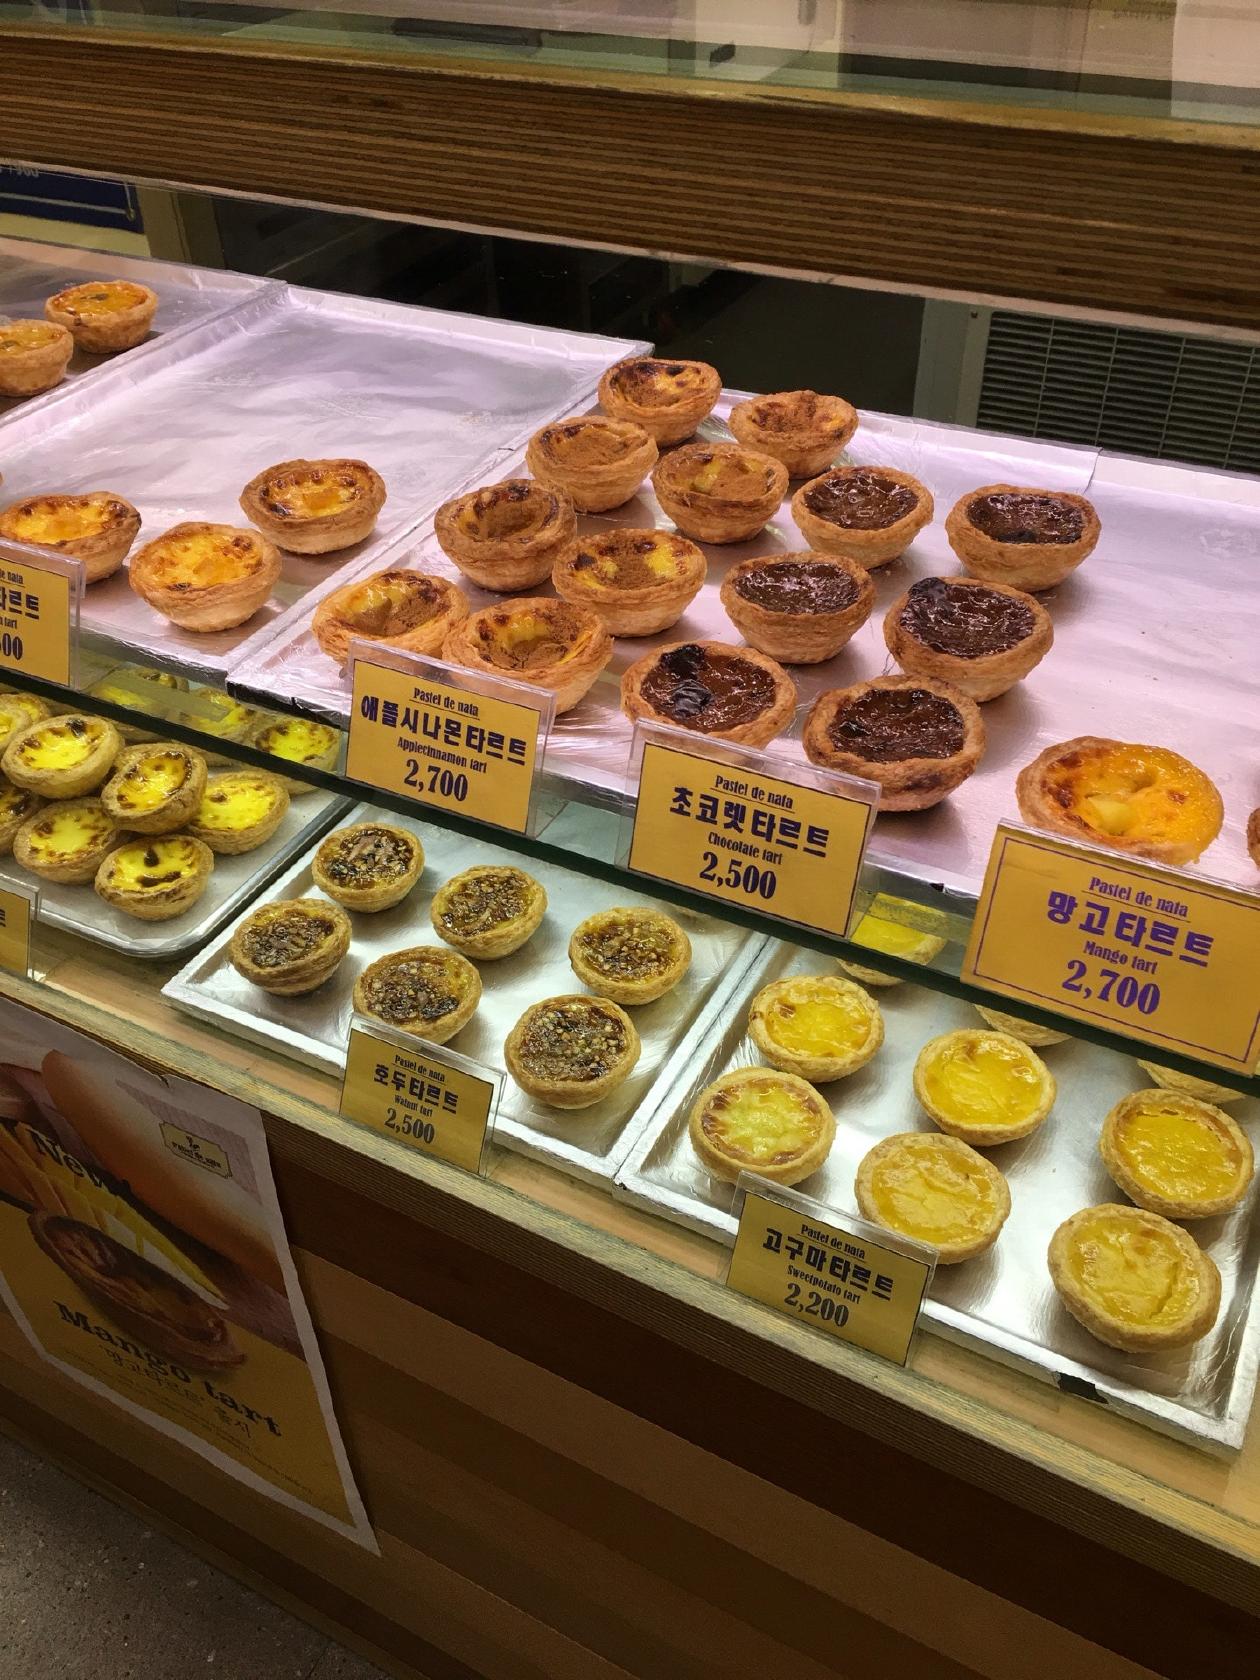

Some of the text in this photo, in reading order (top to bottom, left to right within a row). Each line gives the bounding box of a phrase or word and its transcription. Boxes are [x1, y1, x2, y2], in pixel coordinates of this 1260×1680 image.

[7, 571, 23, 583] nata
[5, 618, 17, 629] tart
[414, 687, 478, 716] Pastel de nata
[362, 695, 526, 765] 애플시나몬타르트
[398, 737, 487, 773] Applecinnamon tart
[404, 759, 468, 801] 2,700
[715, 774, 793, 808] Pastel de nata
[670, 785, 829, 857] 초코렛타르트
[708, 831, 782, 865] Chocolate tart
[700, 851, 776, 899] 2,500
[1089, 876, 1188, 917] Pastel de nata
[1047, 890, 1214, 967] 망고타르트
[1084, 940, 1158, 974] Mango tart
[1062, 959, 1160, 1014] 2,700
[395, 1054, 444, 1082] Pastel de nata
[375, 1063, 458, 1114] 호두타르트
[395, 1094, 433, 1117] Walnut tart
[385, 1107, 434, 1143] 2,500
[801, 1223, 865, 1259] Pastel de nata
[763, 1227, 893, 1301] 고구마타르트
[788, 1264, 860, 1304] Sweetpotato tart
[784, 1282, 848, 1327] 2,200
[53, 1299, 192, 1384] Mango
[204, 1380, 282, 1437] tart
